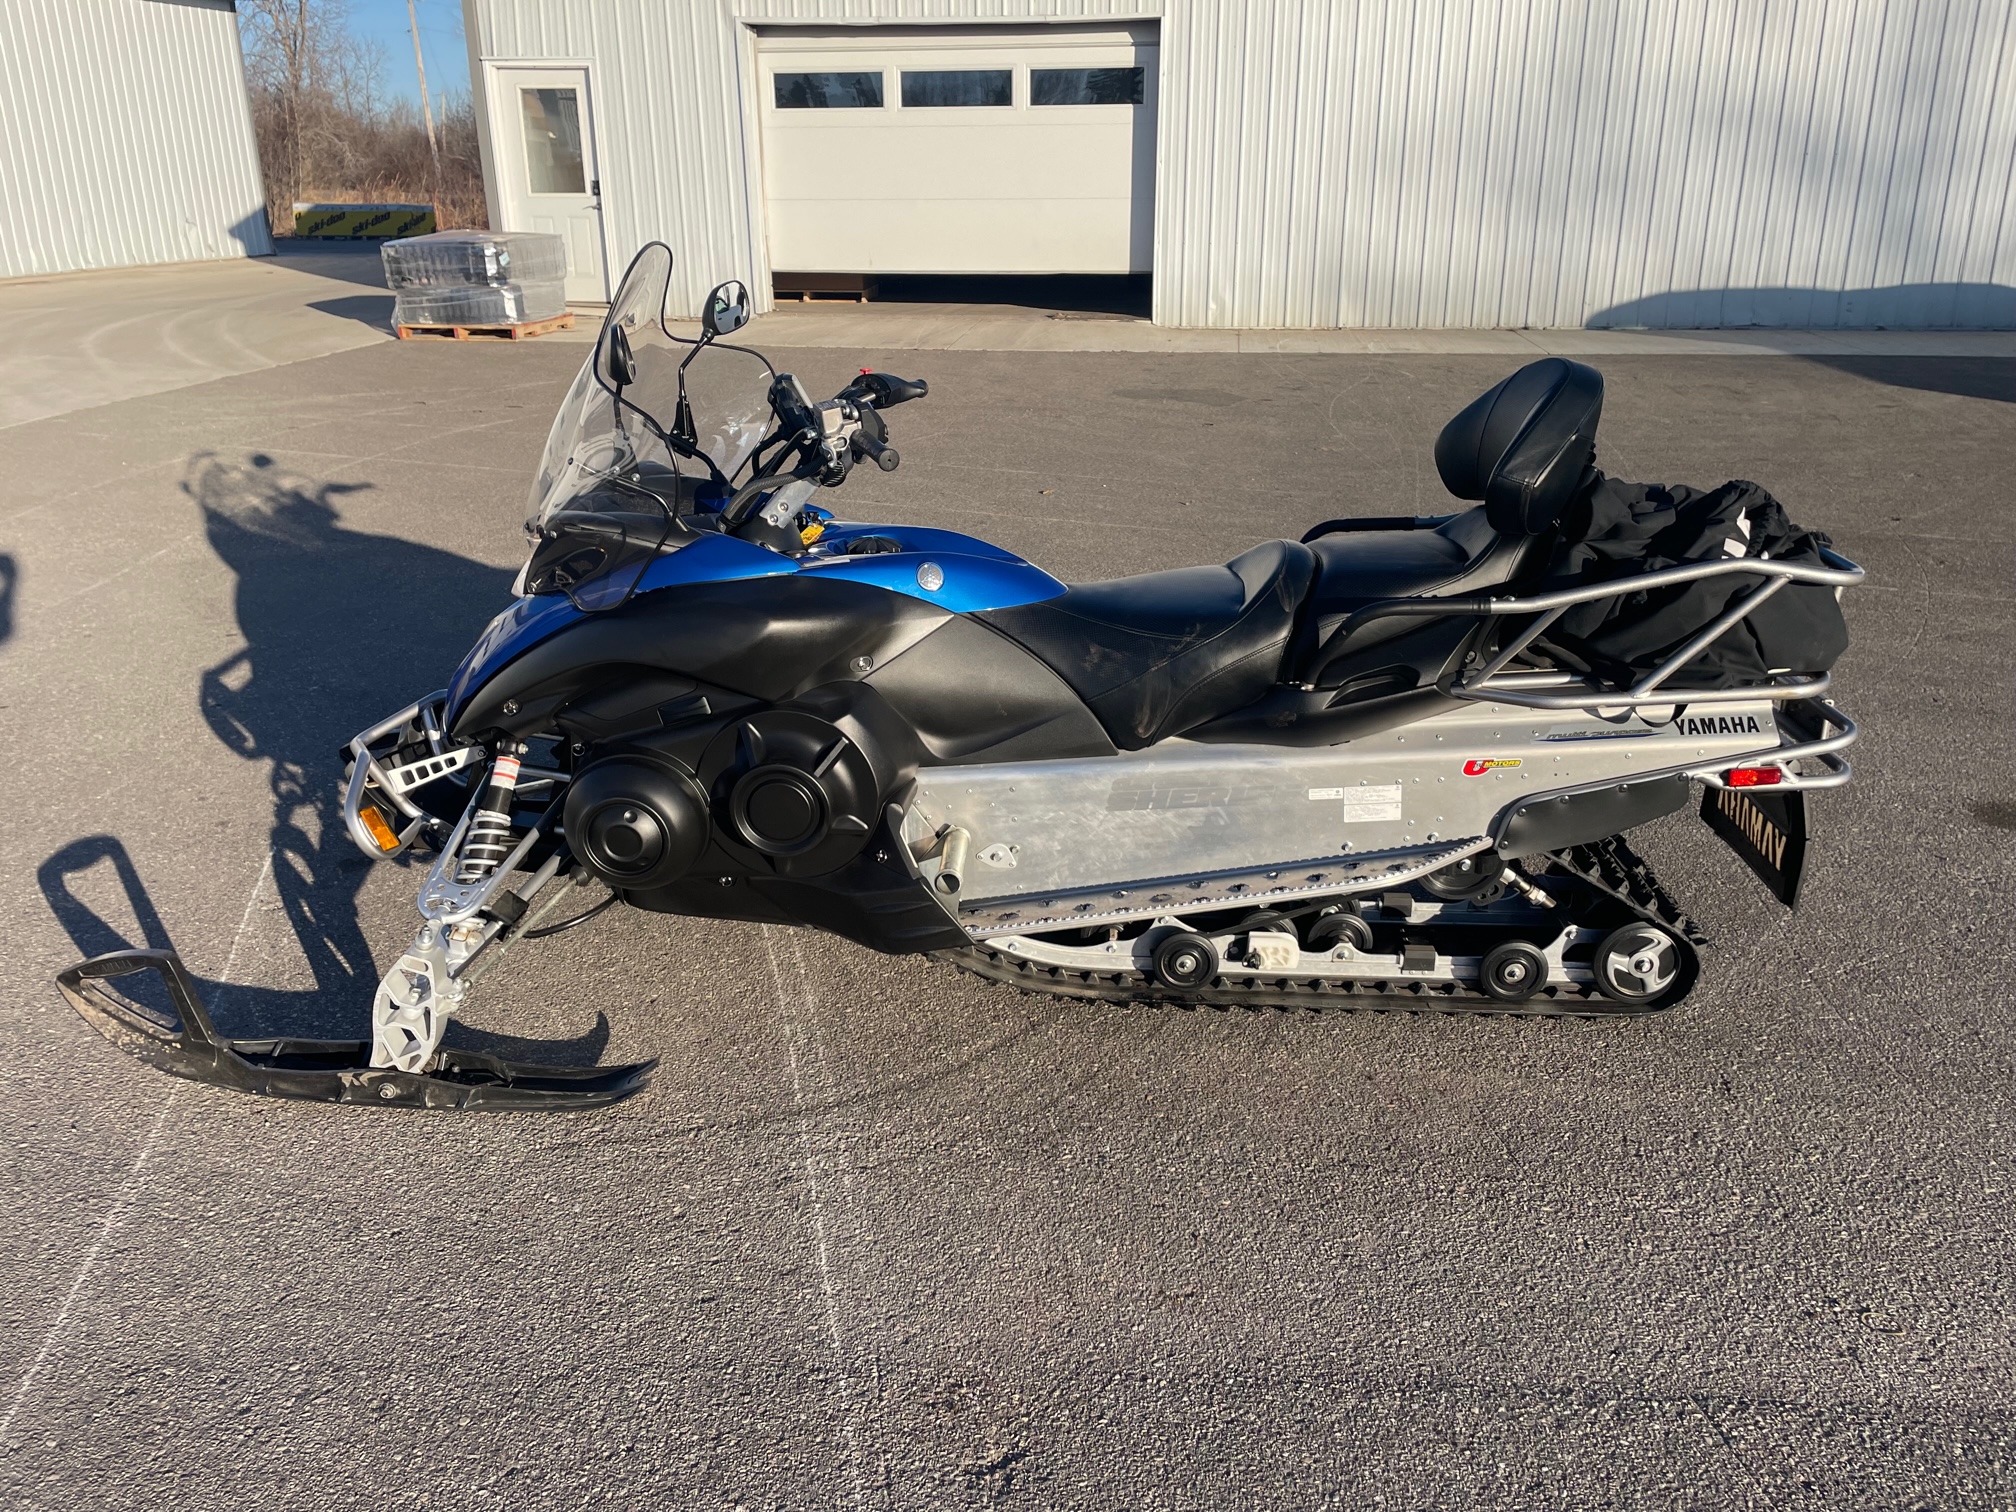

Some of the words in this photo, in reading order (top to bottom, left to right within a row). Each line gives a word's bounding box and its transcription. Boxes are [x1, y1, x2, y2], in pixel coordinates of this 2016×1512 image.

[308, 211, 346, 235] ski-doo
[352, 211, 391, 235] ski-doo
[1674, 715, 1760, 735] YAMAHA
